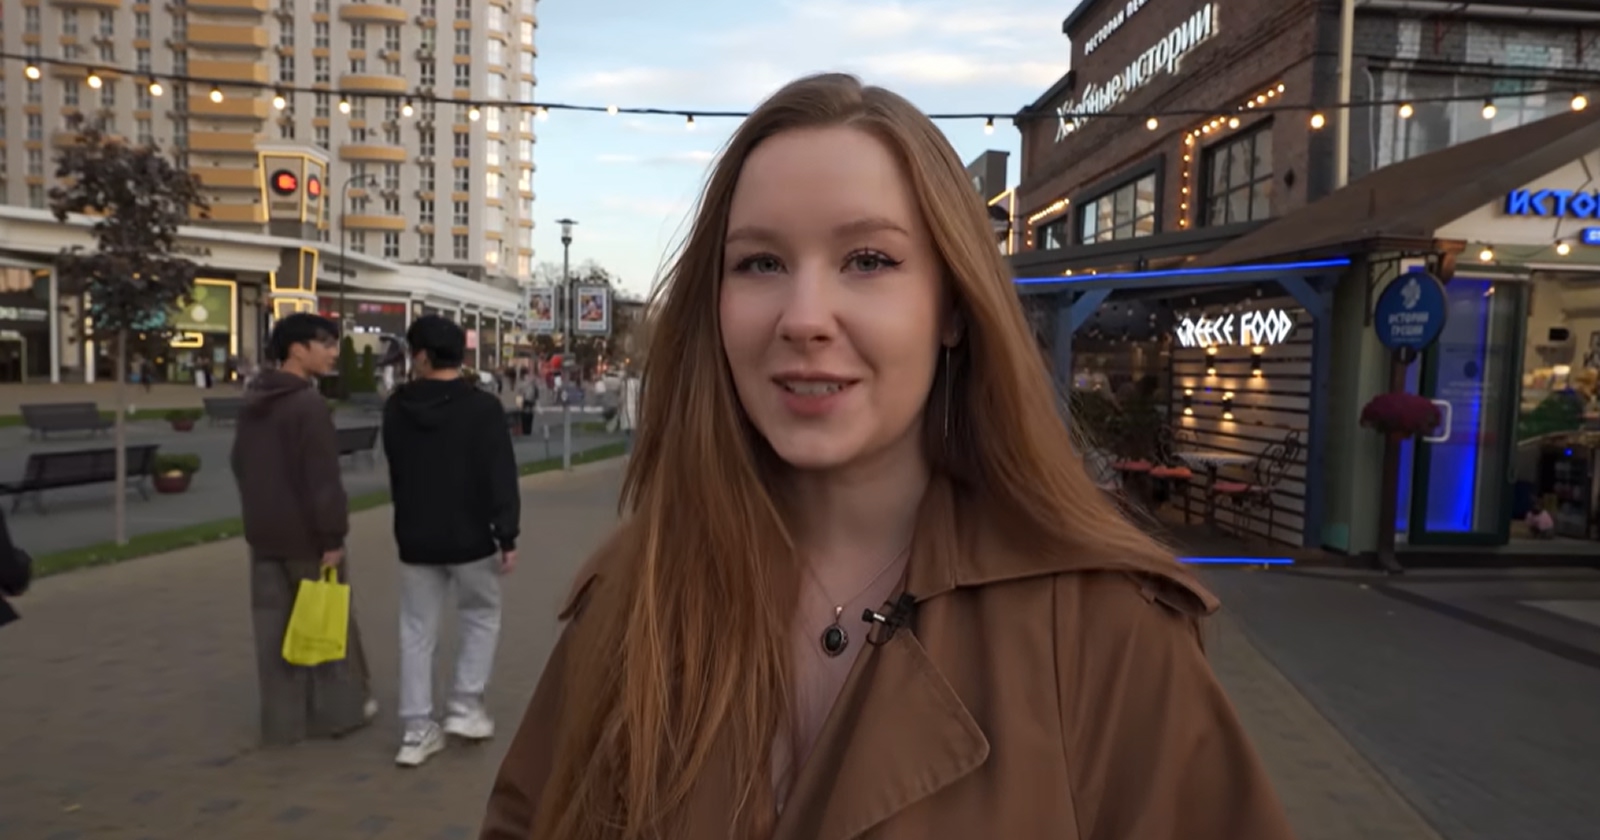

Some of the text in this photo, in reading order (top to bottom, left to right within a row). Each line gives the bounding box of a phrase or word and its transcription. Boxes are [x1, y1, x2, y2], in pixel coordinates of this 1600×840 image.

[1507, 188, 1600, 219] ИСТО
[1177, 308, 1292, 348] GREECE FOOD
